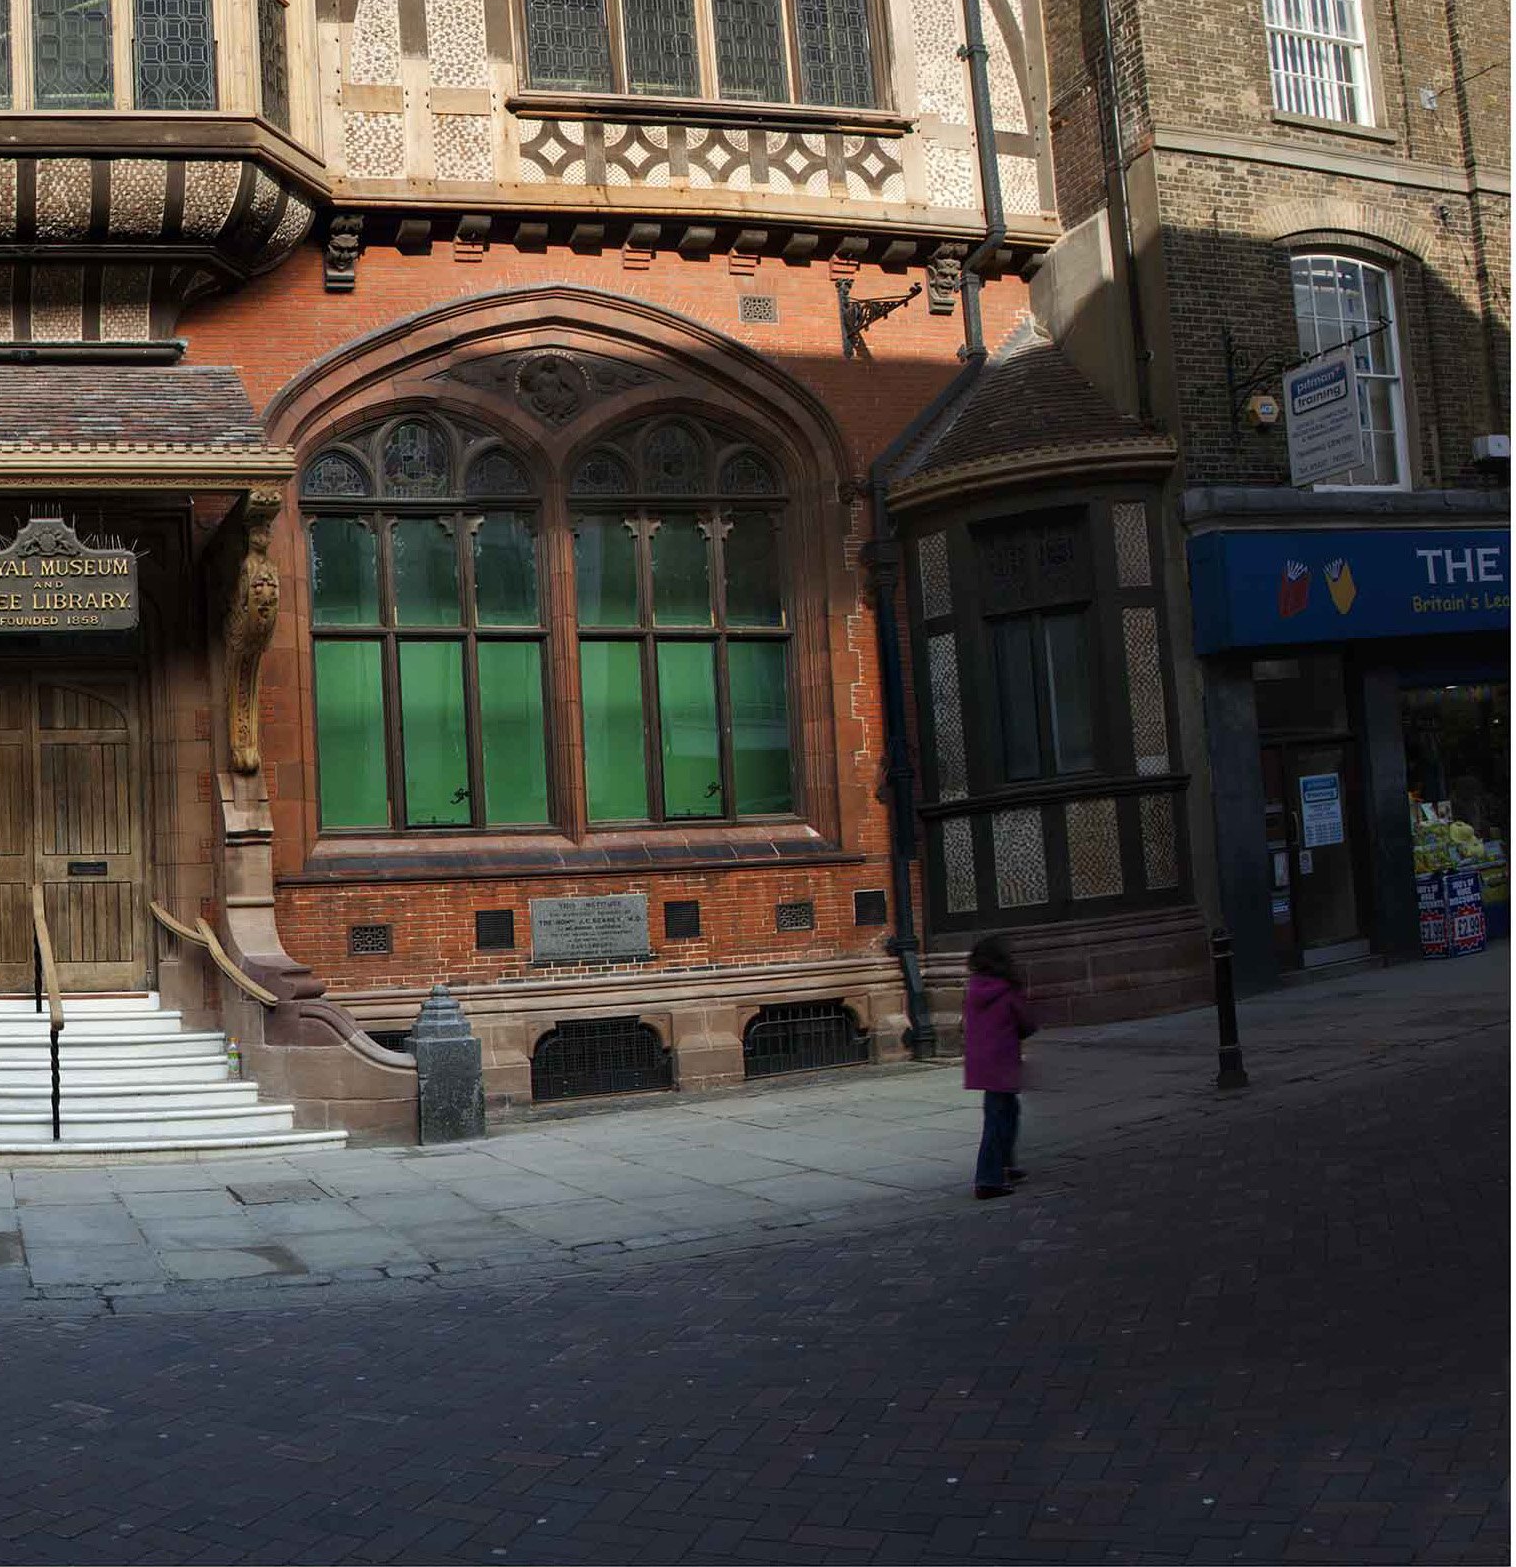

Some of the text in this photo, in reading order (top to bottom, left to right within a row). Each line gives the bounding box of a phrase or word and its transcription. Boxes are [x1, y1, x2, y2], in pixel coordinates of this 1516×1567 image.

[1297, 370, 1336, 395] pitman
[1297, 384, 1341, 407] training
[41, 559, 129, 576] MUSEUM
[1416, 547, 1504, 584] THE
[33, 581, 64, 589] AND
[1412, 593, 1479, 613] Britain's
